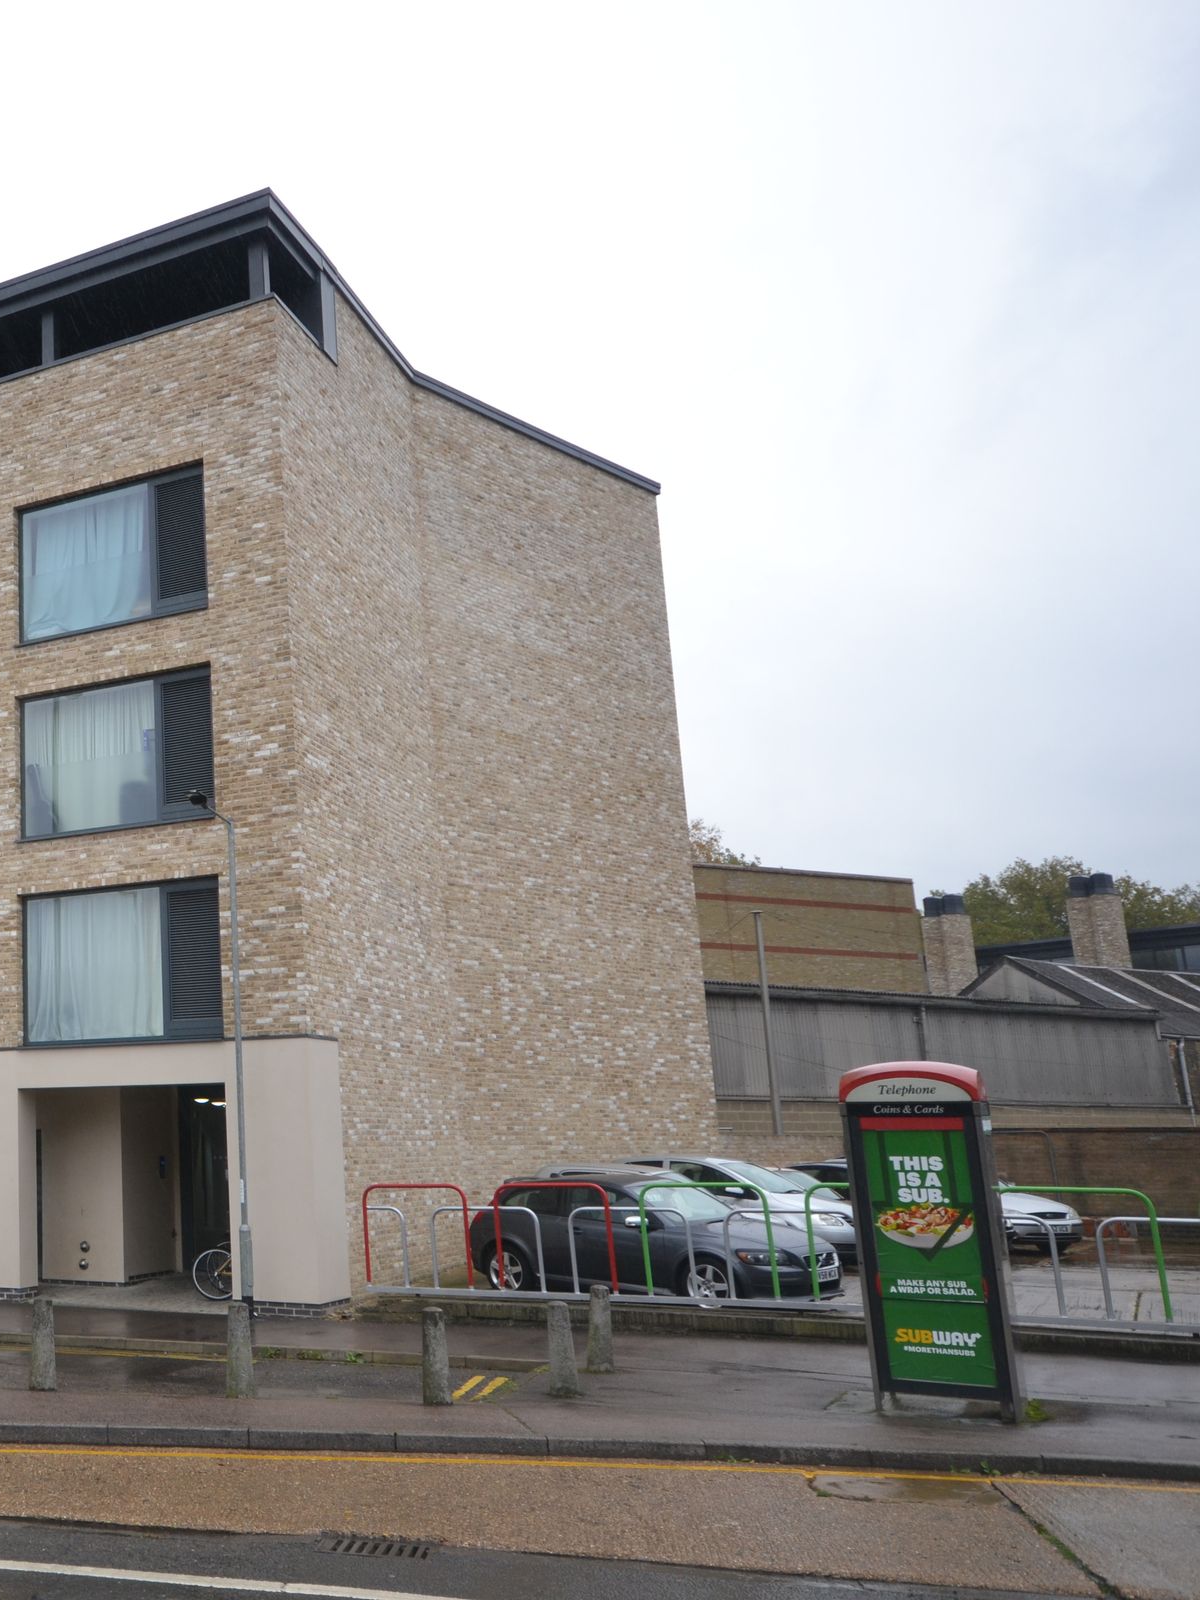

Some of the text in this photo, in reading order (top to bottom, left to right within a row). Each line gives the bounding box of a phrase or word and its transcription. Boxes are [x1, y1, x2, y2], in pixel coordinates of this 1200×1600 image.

[878, 1084, 936, 1097] Telephone
[873, 1105, 944, 1114] Coins & Cards
[889, 1156, 944, 1171] THIS
[898, 1172, 942, 1187] IS A
[897, 1188, 950, 1204] SUB.
[897, 1279, 967, 1288] MAKE ANY SUB
[890, 1286, 977, 1296] A WRAP OR SALAD.
[895, 1328, 982, 1347] SUBWAY
[903, 1345, 976, 1357] #MORETHANSUBS
